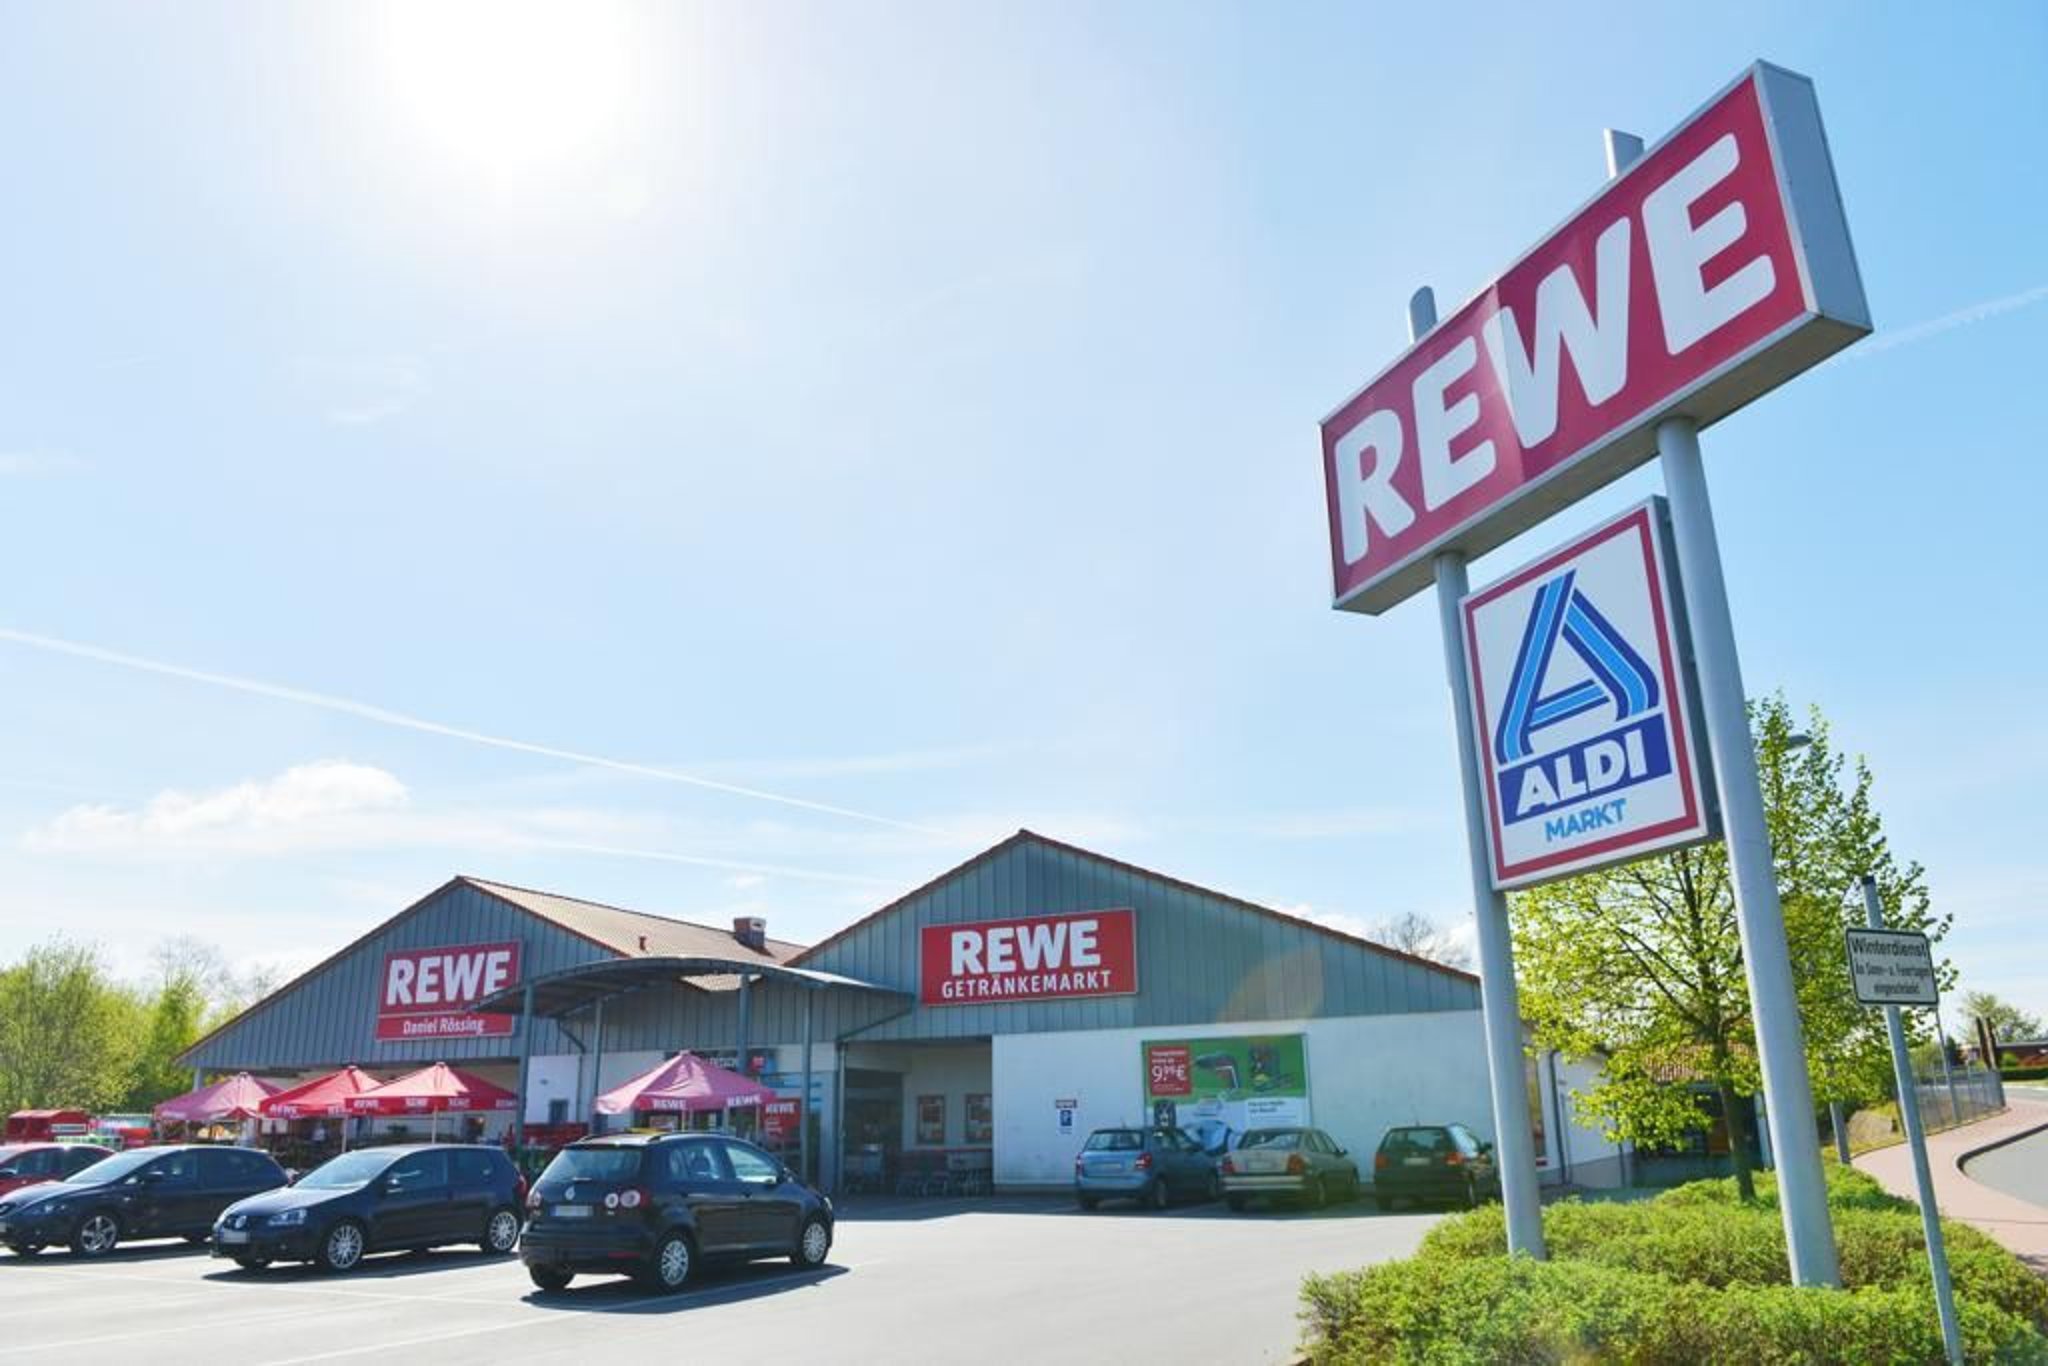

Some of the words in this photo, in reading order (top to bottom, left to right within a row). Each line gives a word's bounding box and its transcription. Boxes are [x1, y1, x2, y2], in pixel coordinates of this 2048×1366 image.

[1335, 133, 1776, 565] REWE
[1516, 728, 1649, 817] ALDI
[1544, 797, 1628, 843] MARKT
[951, 919, 1101, 977] REWE
[1850, 936, 1927, 959] Winterdienst
[386, 951, 512, 1006] REWE
[942, 970, 1112, 999] GETRÄNKEMARKT
[402, 1018, 437, 1035] Daniel
[439, 1016, 486, 1036] Rössing
[653, 1099, 687, 1110] REWE
[727, 1093, 762, 1107] REWE
